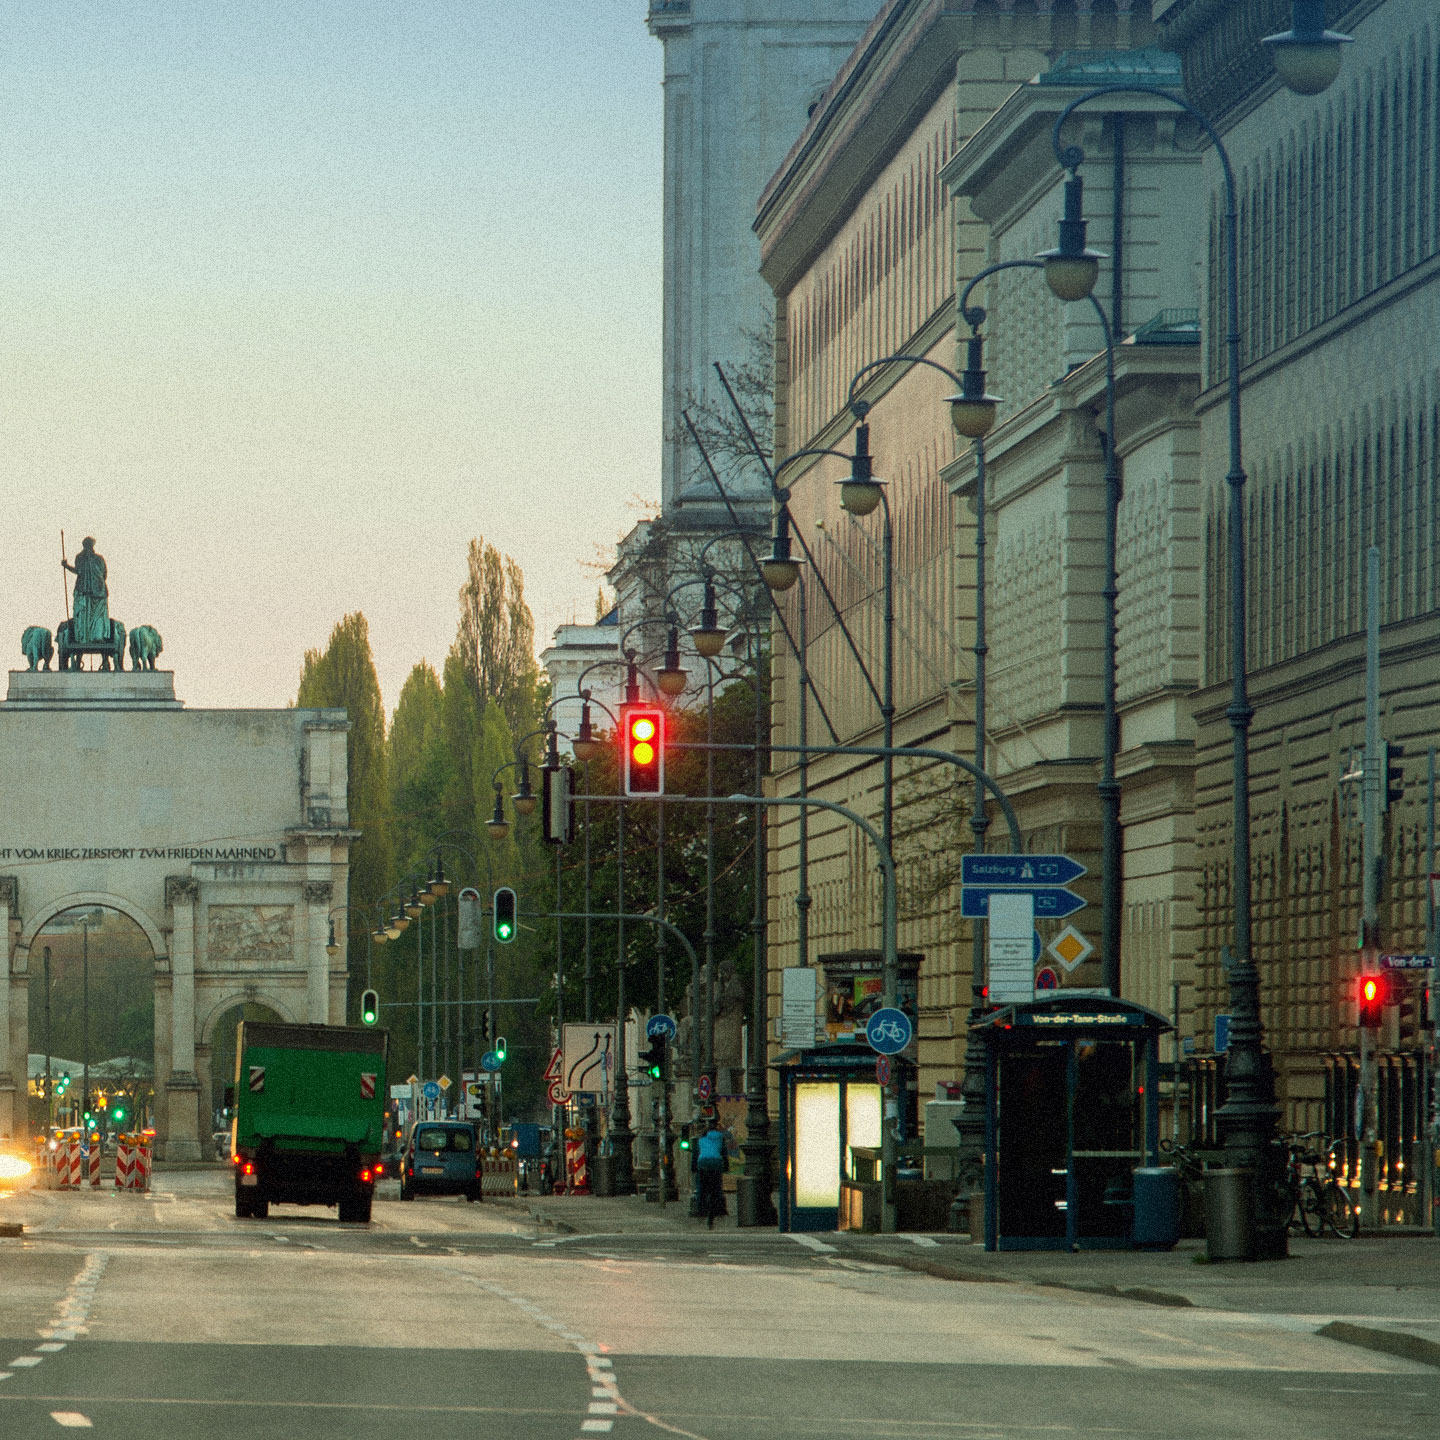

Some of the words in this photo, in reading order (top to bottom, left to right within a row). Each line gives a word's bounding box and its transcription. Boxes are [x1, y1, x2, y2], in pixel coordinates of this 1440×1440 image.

[15, 848, 44, 859] VOM
[47, 848, 79, 859] KRIEG
[168, 848, 213, 859] FRIEDEN
[216, 848, 276, 859] MAHNEND
[972, 864, 1016, 876] Salzburg
[1032, 1014, 1128, 1024] Von-der-Tann-Straße
